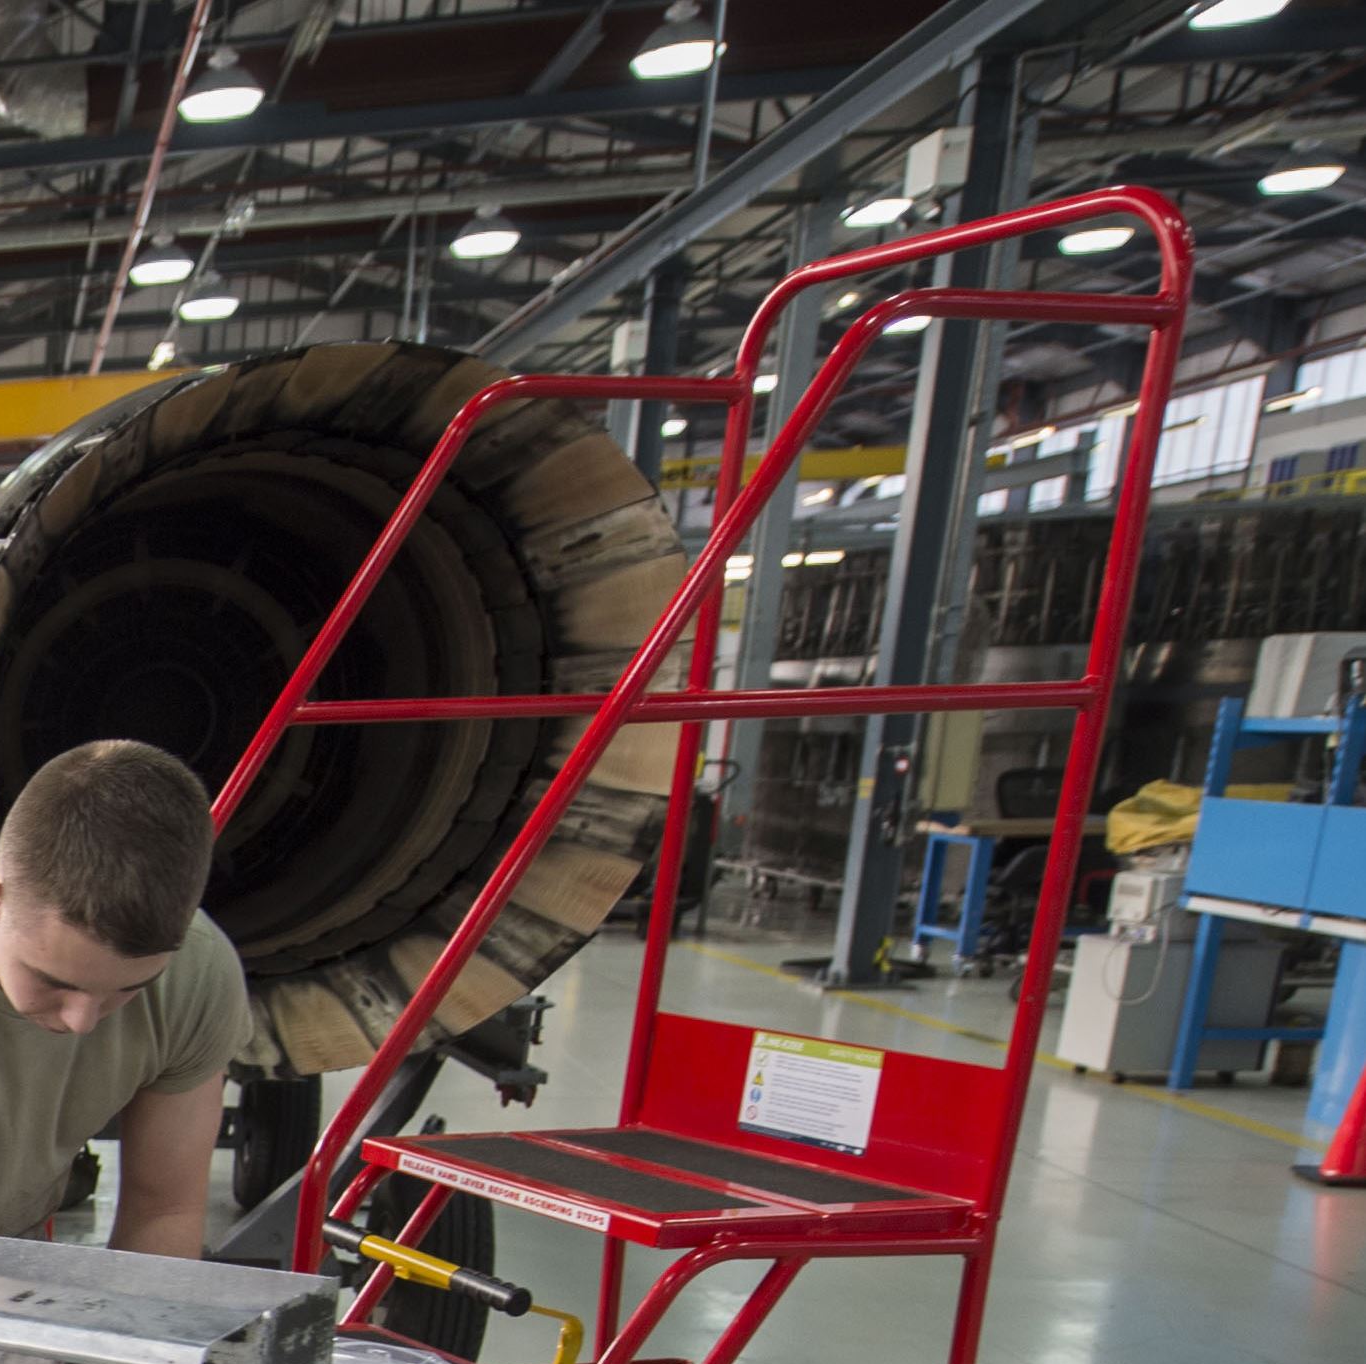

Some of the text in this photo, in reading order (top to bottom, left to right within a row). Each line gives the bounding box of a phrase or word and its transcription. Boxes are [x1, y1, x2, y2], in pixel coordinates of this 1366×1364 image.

[403, 1158, 436, 1176] RELEASE
[460, 1176, 486, 1192] LEVER
[488, 1184, 520, 1202] BEFORE
[524, 1195, 573, 1218] ASCENDING
[575, 1210, 605, 1227] STEPS
